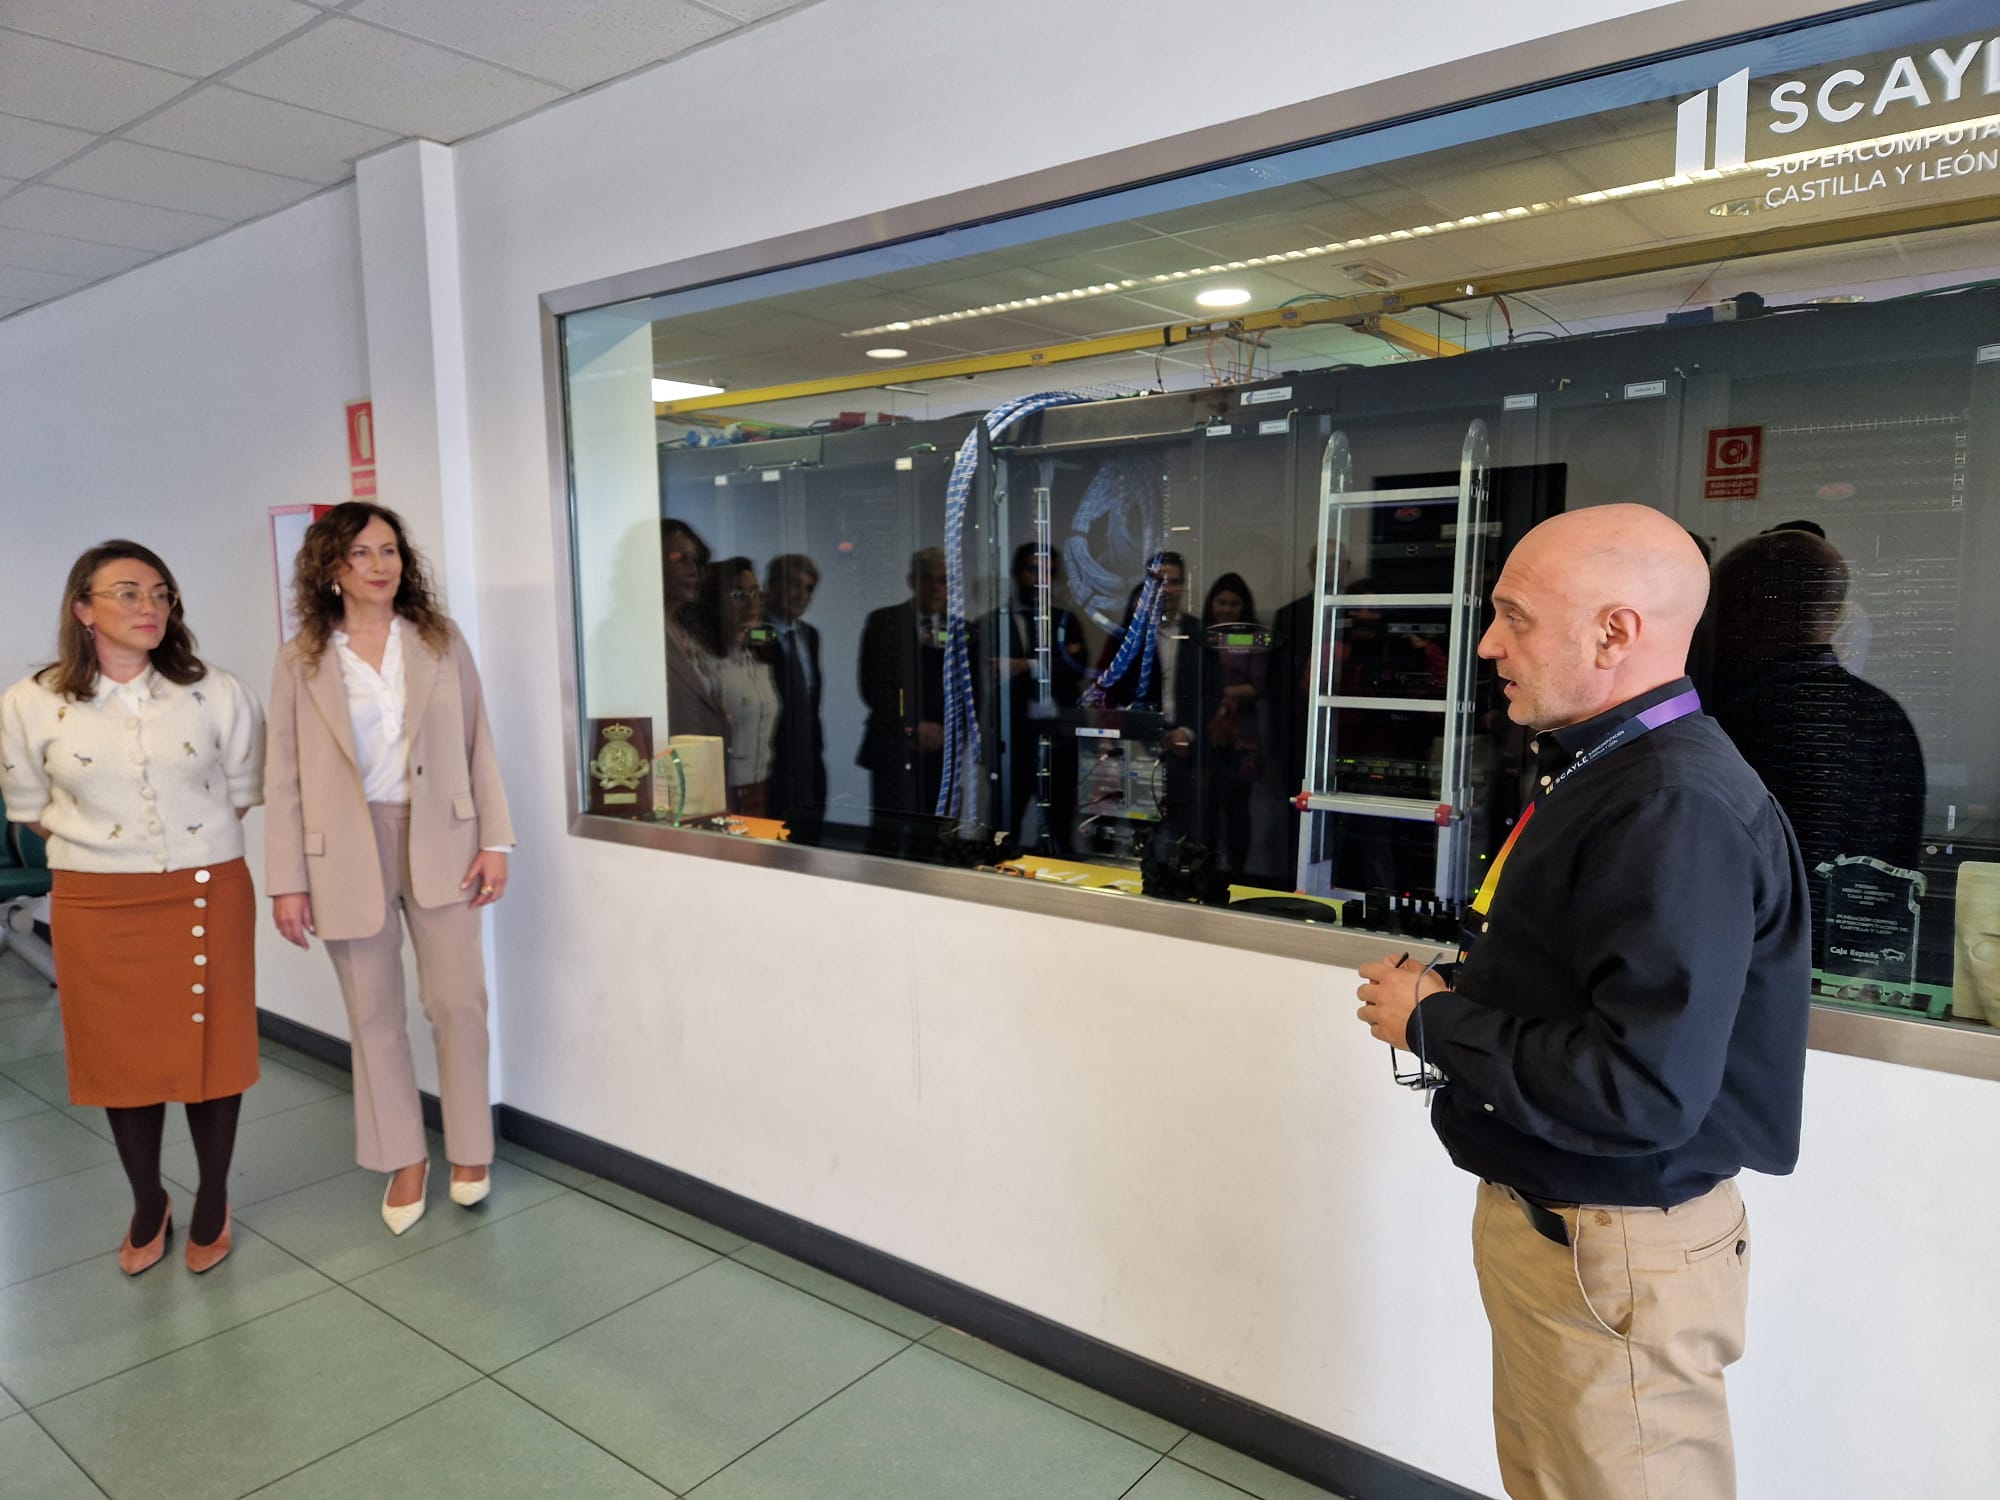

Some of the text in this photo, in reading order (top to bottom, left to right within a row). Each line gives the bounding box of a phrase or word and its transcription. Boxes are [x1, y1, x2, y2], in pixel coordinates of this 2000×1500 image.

[1765, 149, 1999, 208] CASTILLA Y LEÓN
[1555, 756, 1589, 784] SCAYLE
[1830, 946, 1879, 959] Caja España
